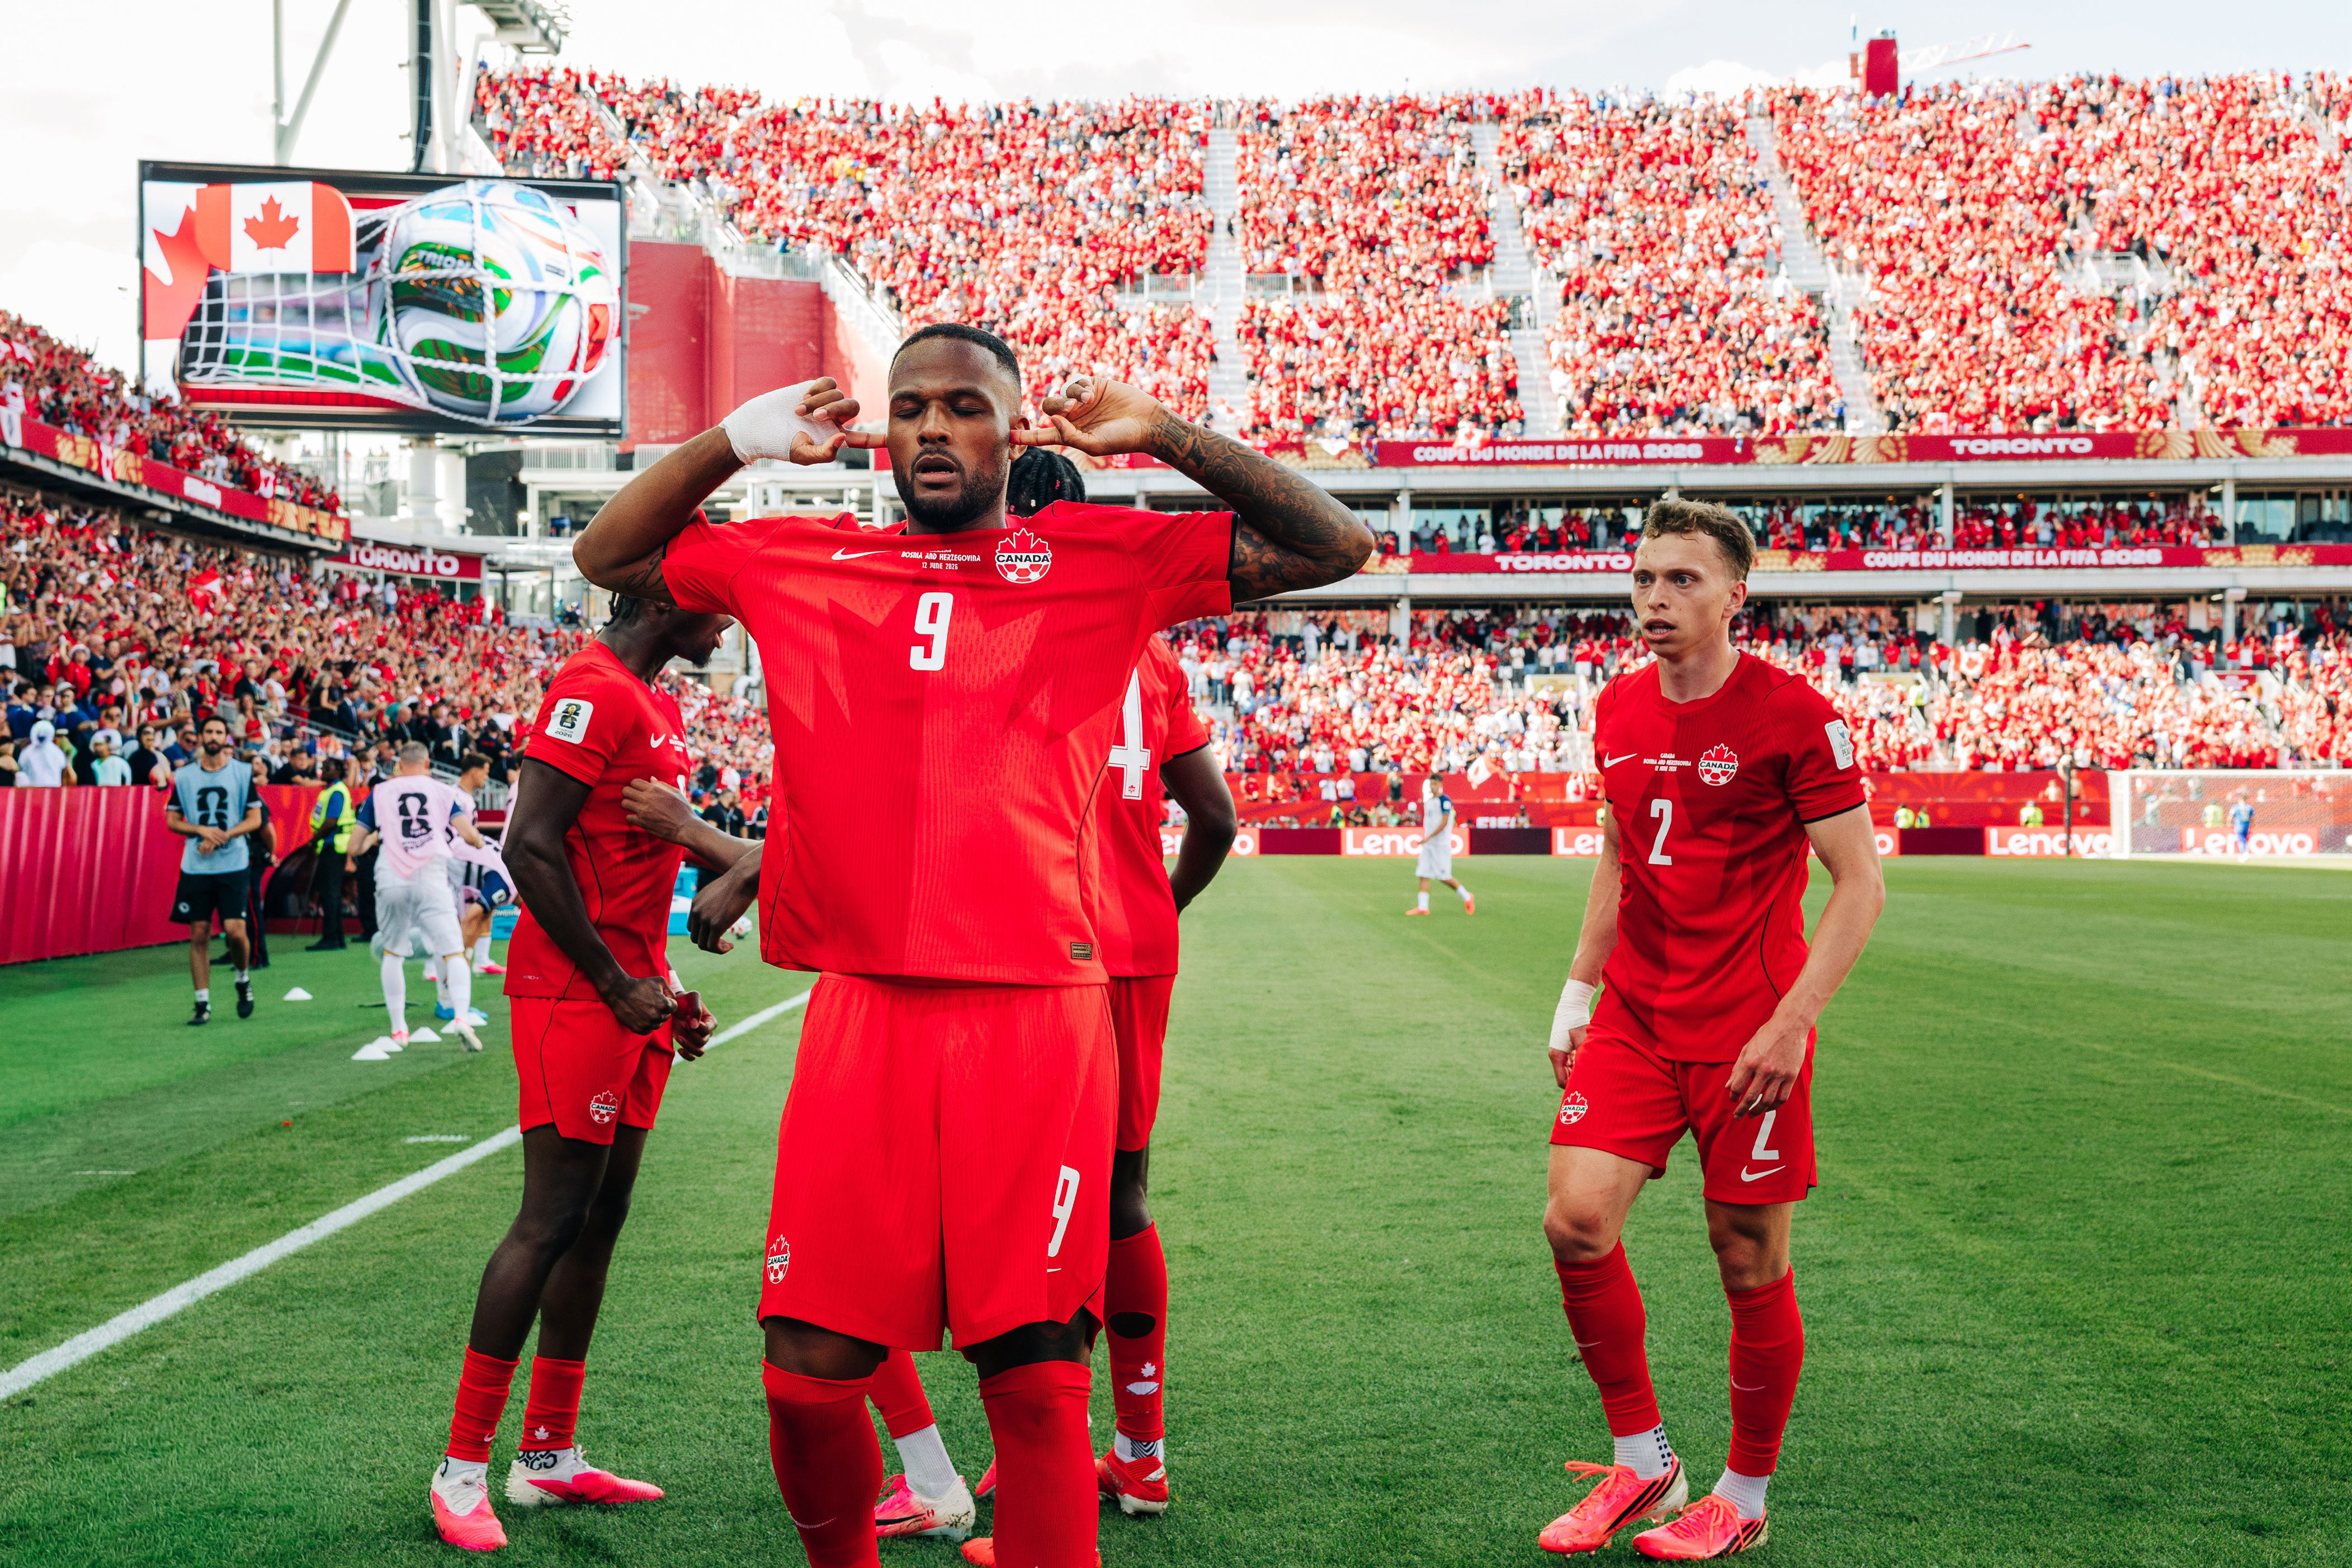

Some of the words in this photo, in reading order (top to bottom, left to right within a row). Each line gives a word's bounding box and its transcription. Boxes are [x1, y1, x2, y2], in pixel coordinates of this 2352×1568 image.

[1413, 446, 1468, 461] COUPE
[1470, 446, 1494, 461] DU
[1495, 445, 1555, 460] MONDE
[1556, 445, 1579, 460] DE
[1580, 445, 1603, 460] LA
[1604, 444, 1641, 459] FIFA
[1643, 443, 1703, 459] 2026
[1949, 438, 2093, 455] TORONTO
[349, 545, 459, 575] TORONTO
[1495, 554, 1632, 570] TORONTO
[1864, 552, 1920, 567] COUPE
[1921, 551, 1947, 567] DU
[1948, 551, 2010, 566] MONDE
[2010, 550, 2034, 565] DE
[2035, 550, 2059, 565] LA
[2060, 549, 2099, 565] FIFA
[2100, 549, 2162, 565] 2026
[909, 592, 953, 671] 9
[1700, 762, 1736, 770] CANADA
[1648, 799, 1672, 866] 2
[1990, 828, 2116, 856] Lenovo
[591, 1103, 616, 1112] CANADA
[1048, 1165, 1080, 1257] 9
[768, 1255, 788, 1265] CANADA
